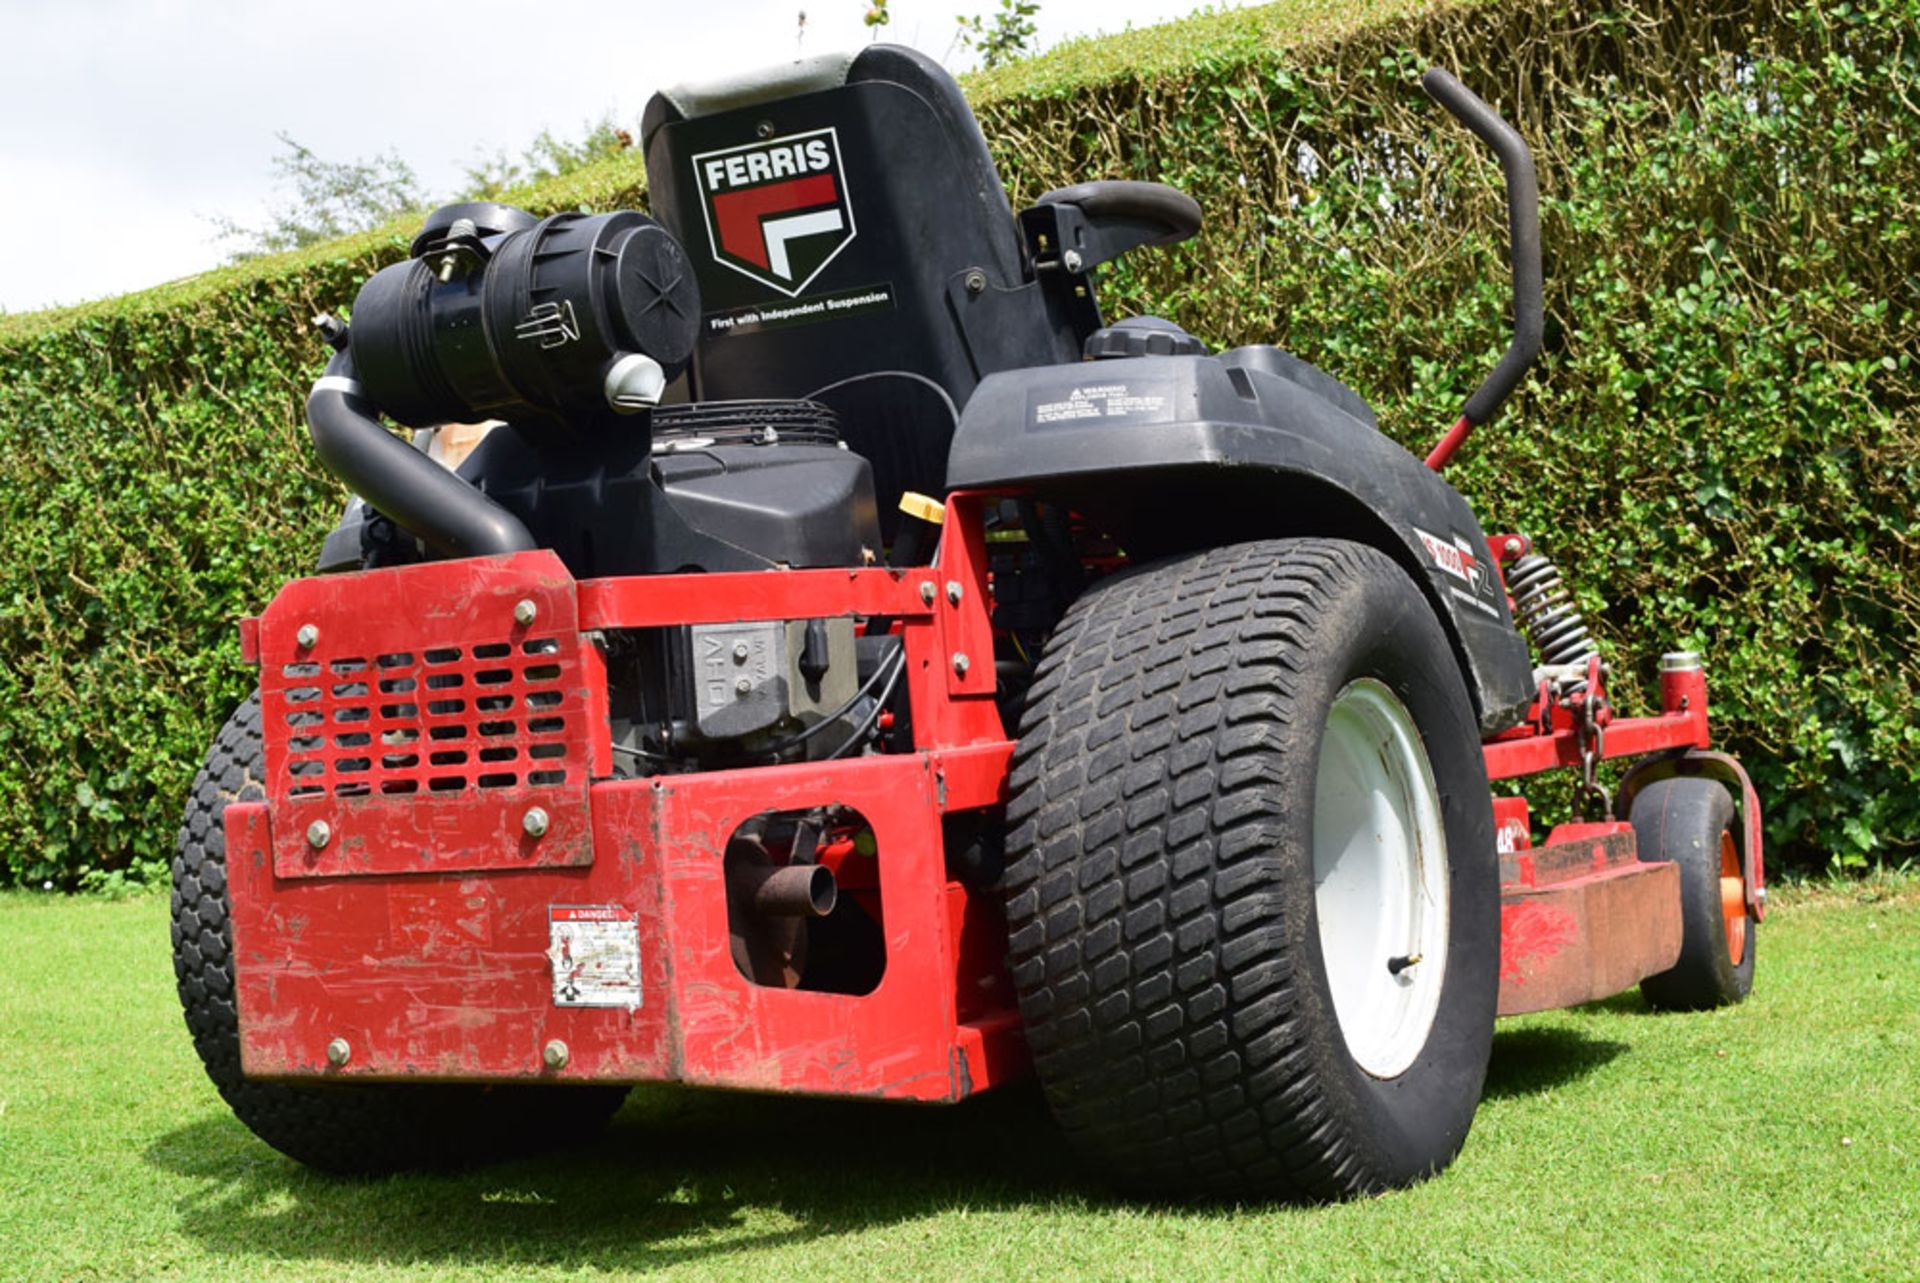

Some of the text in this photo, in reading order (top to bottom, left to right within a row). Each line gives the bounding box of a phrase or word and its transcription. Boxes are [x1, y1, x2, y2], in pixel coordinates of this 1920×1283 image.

[705, 140, 830, 190] FERRIS
[711, 292, 888, 329] First with Independent Suspension
